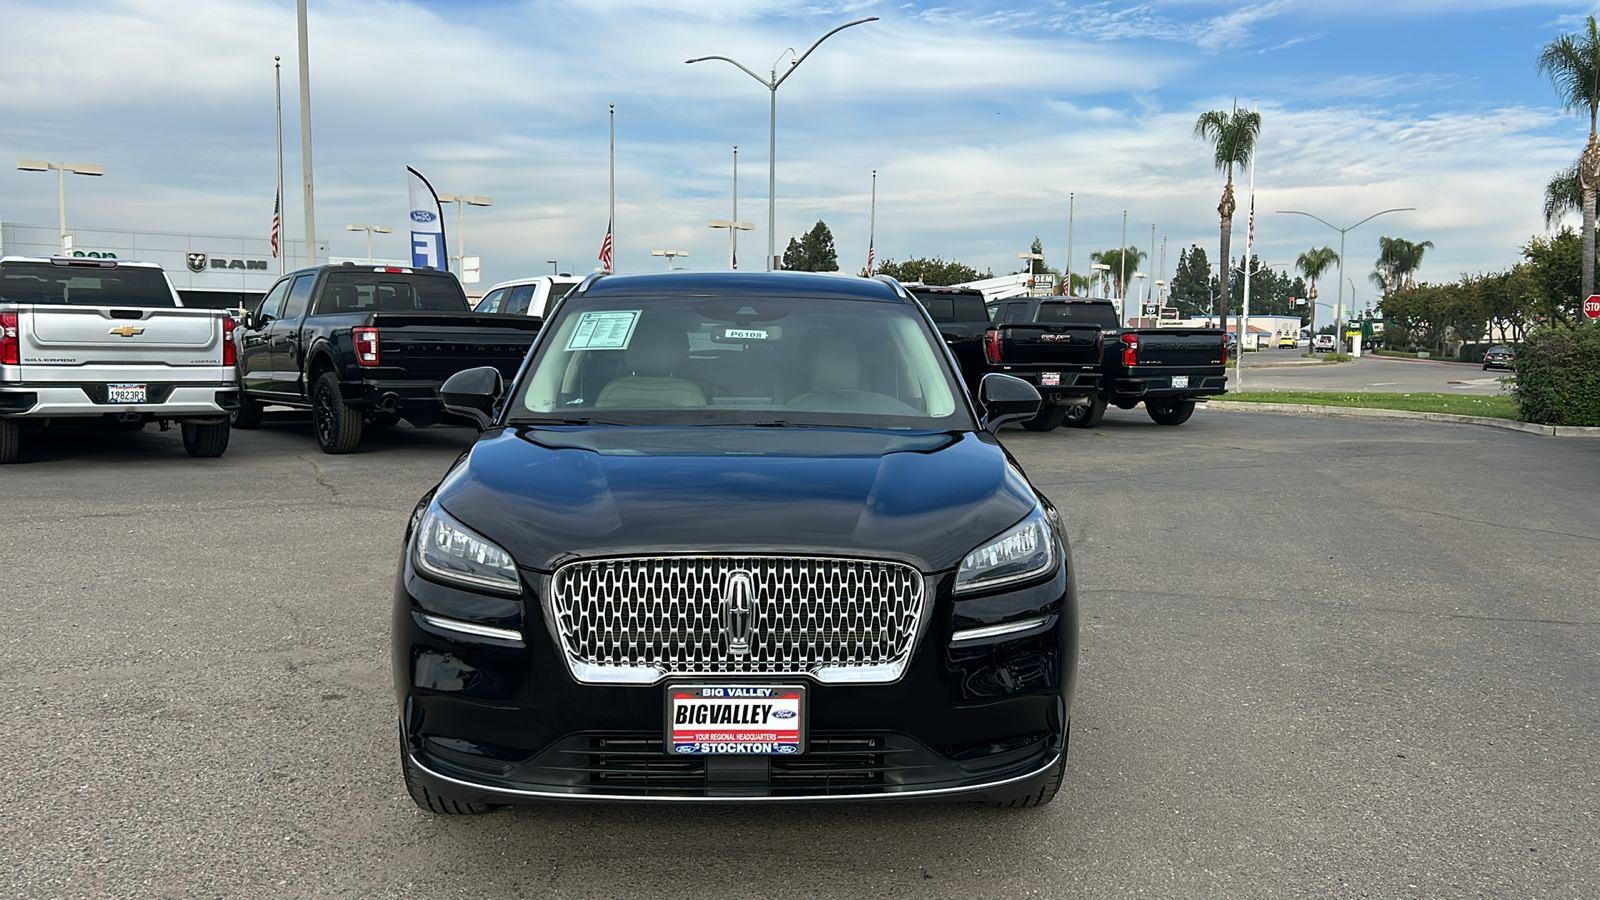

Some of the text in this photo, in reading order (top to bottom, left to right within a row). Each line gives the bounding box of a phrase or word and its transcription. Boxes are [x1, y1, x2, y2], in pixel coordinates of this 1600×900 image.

[210, 258, 267, 270] RAM
[1034, 275, 1053, 283] OEM
[1585, 302, 1600, 312] STO
[110, 390, 145, 400] 19823R3
[702, 688, 772, 697] BIG VALLEY
[675, 704, 773, 724] BIGVALLEY
[695, 733, 777, 741] YOUR REGIONAL HEADQUARTERS
[701, 743, 771, 753] STOCKTON
